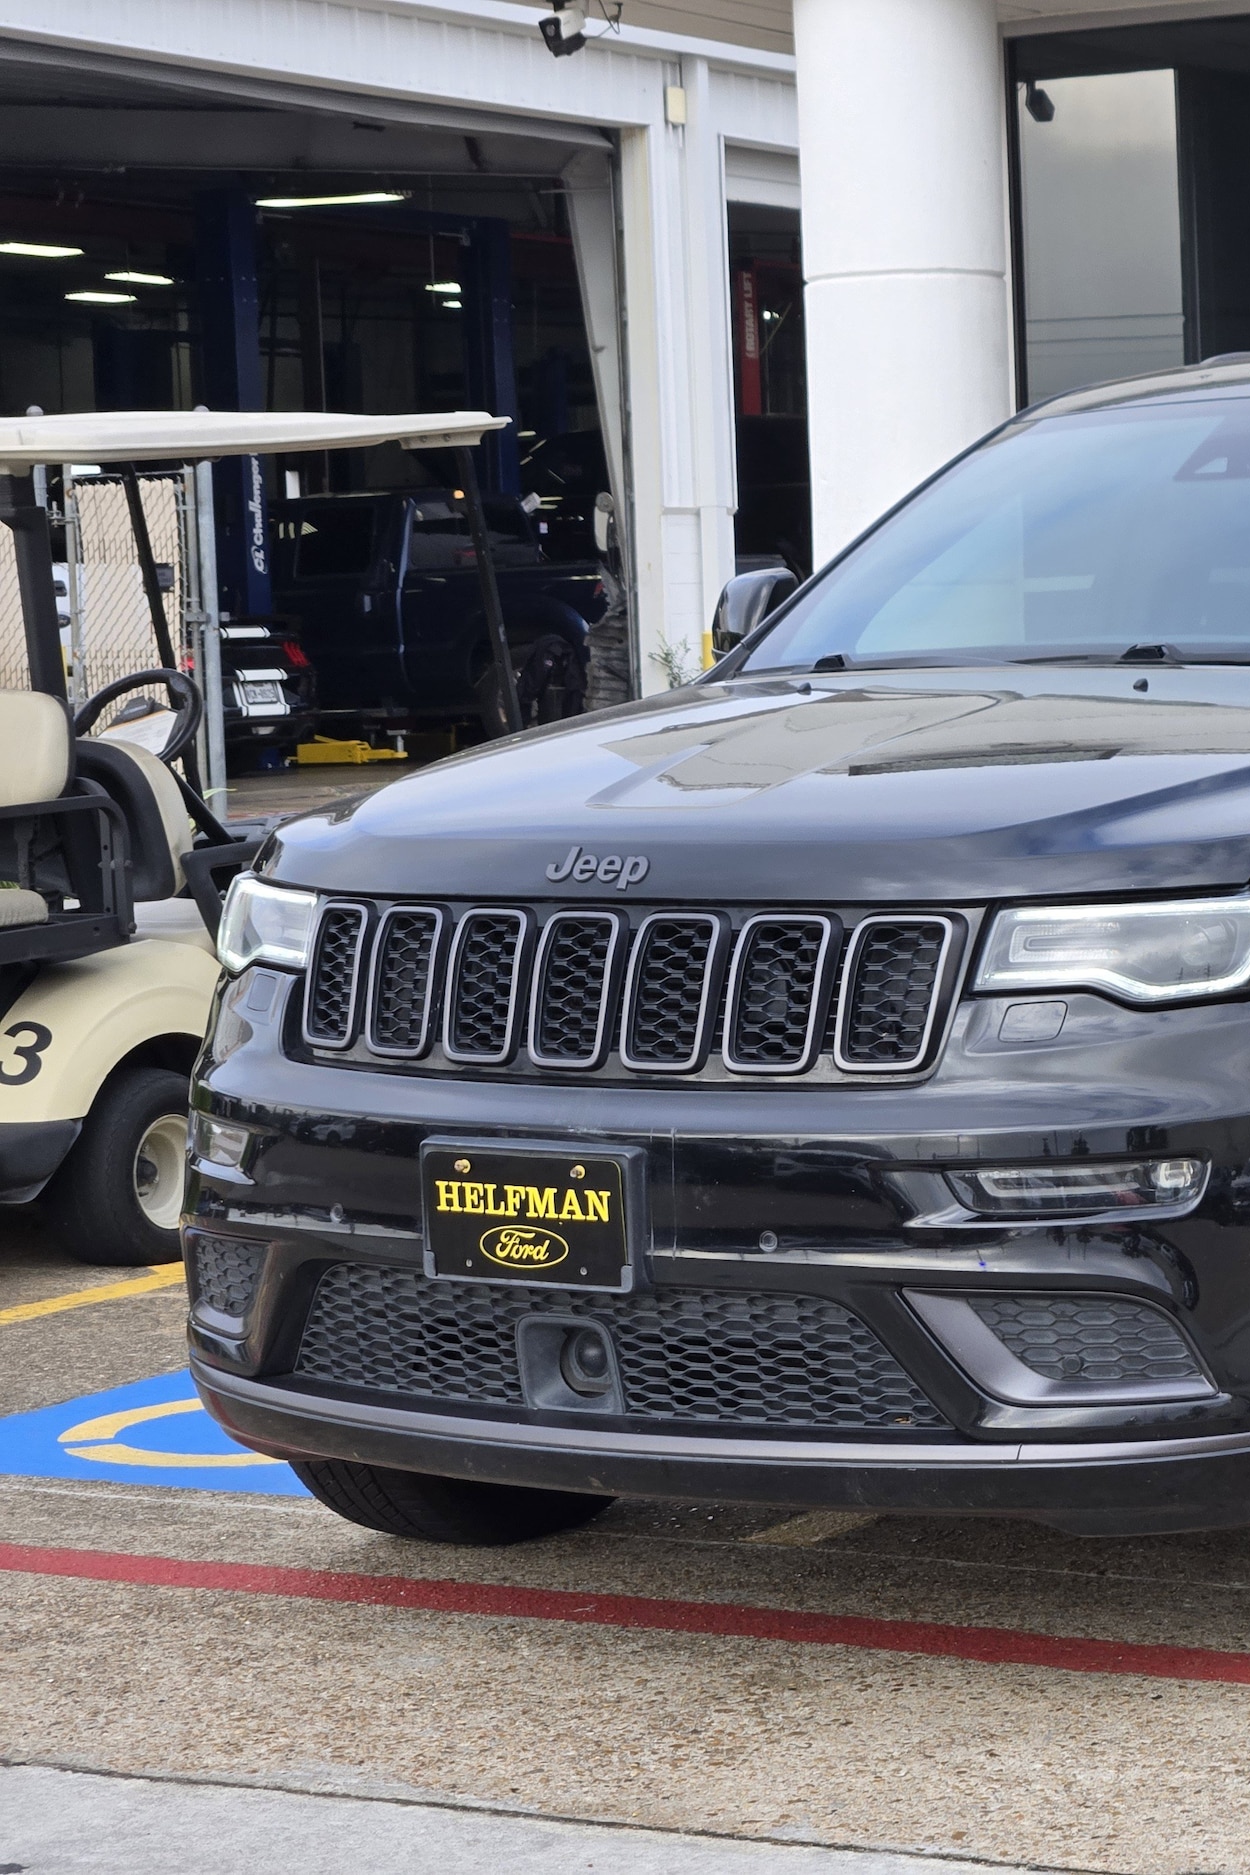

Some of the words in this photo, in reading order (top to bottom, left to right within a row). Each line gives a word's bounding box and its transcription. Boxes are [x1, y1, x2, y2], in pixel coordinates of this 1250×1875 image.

[742, 272, 753, 298] LIFT
[743, 301, 756, 351] ROTARY
[249, 457, 264, 545] Challenger
[545, 846, 649, 891] Jeep
[0, 1021, 53, 1086] 3
[435, 1180, 611, 1222] HELFMAN
[495, 1229, 551, 1261] Ford
